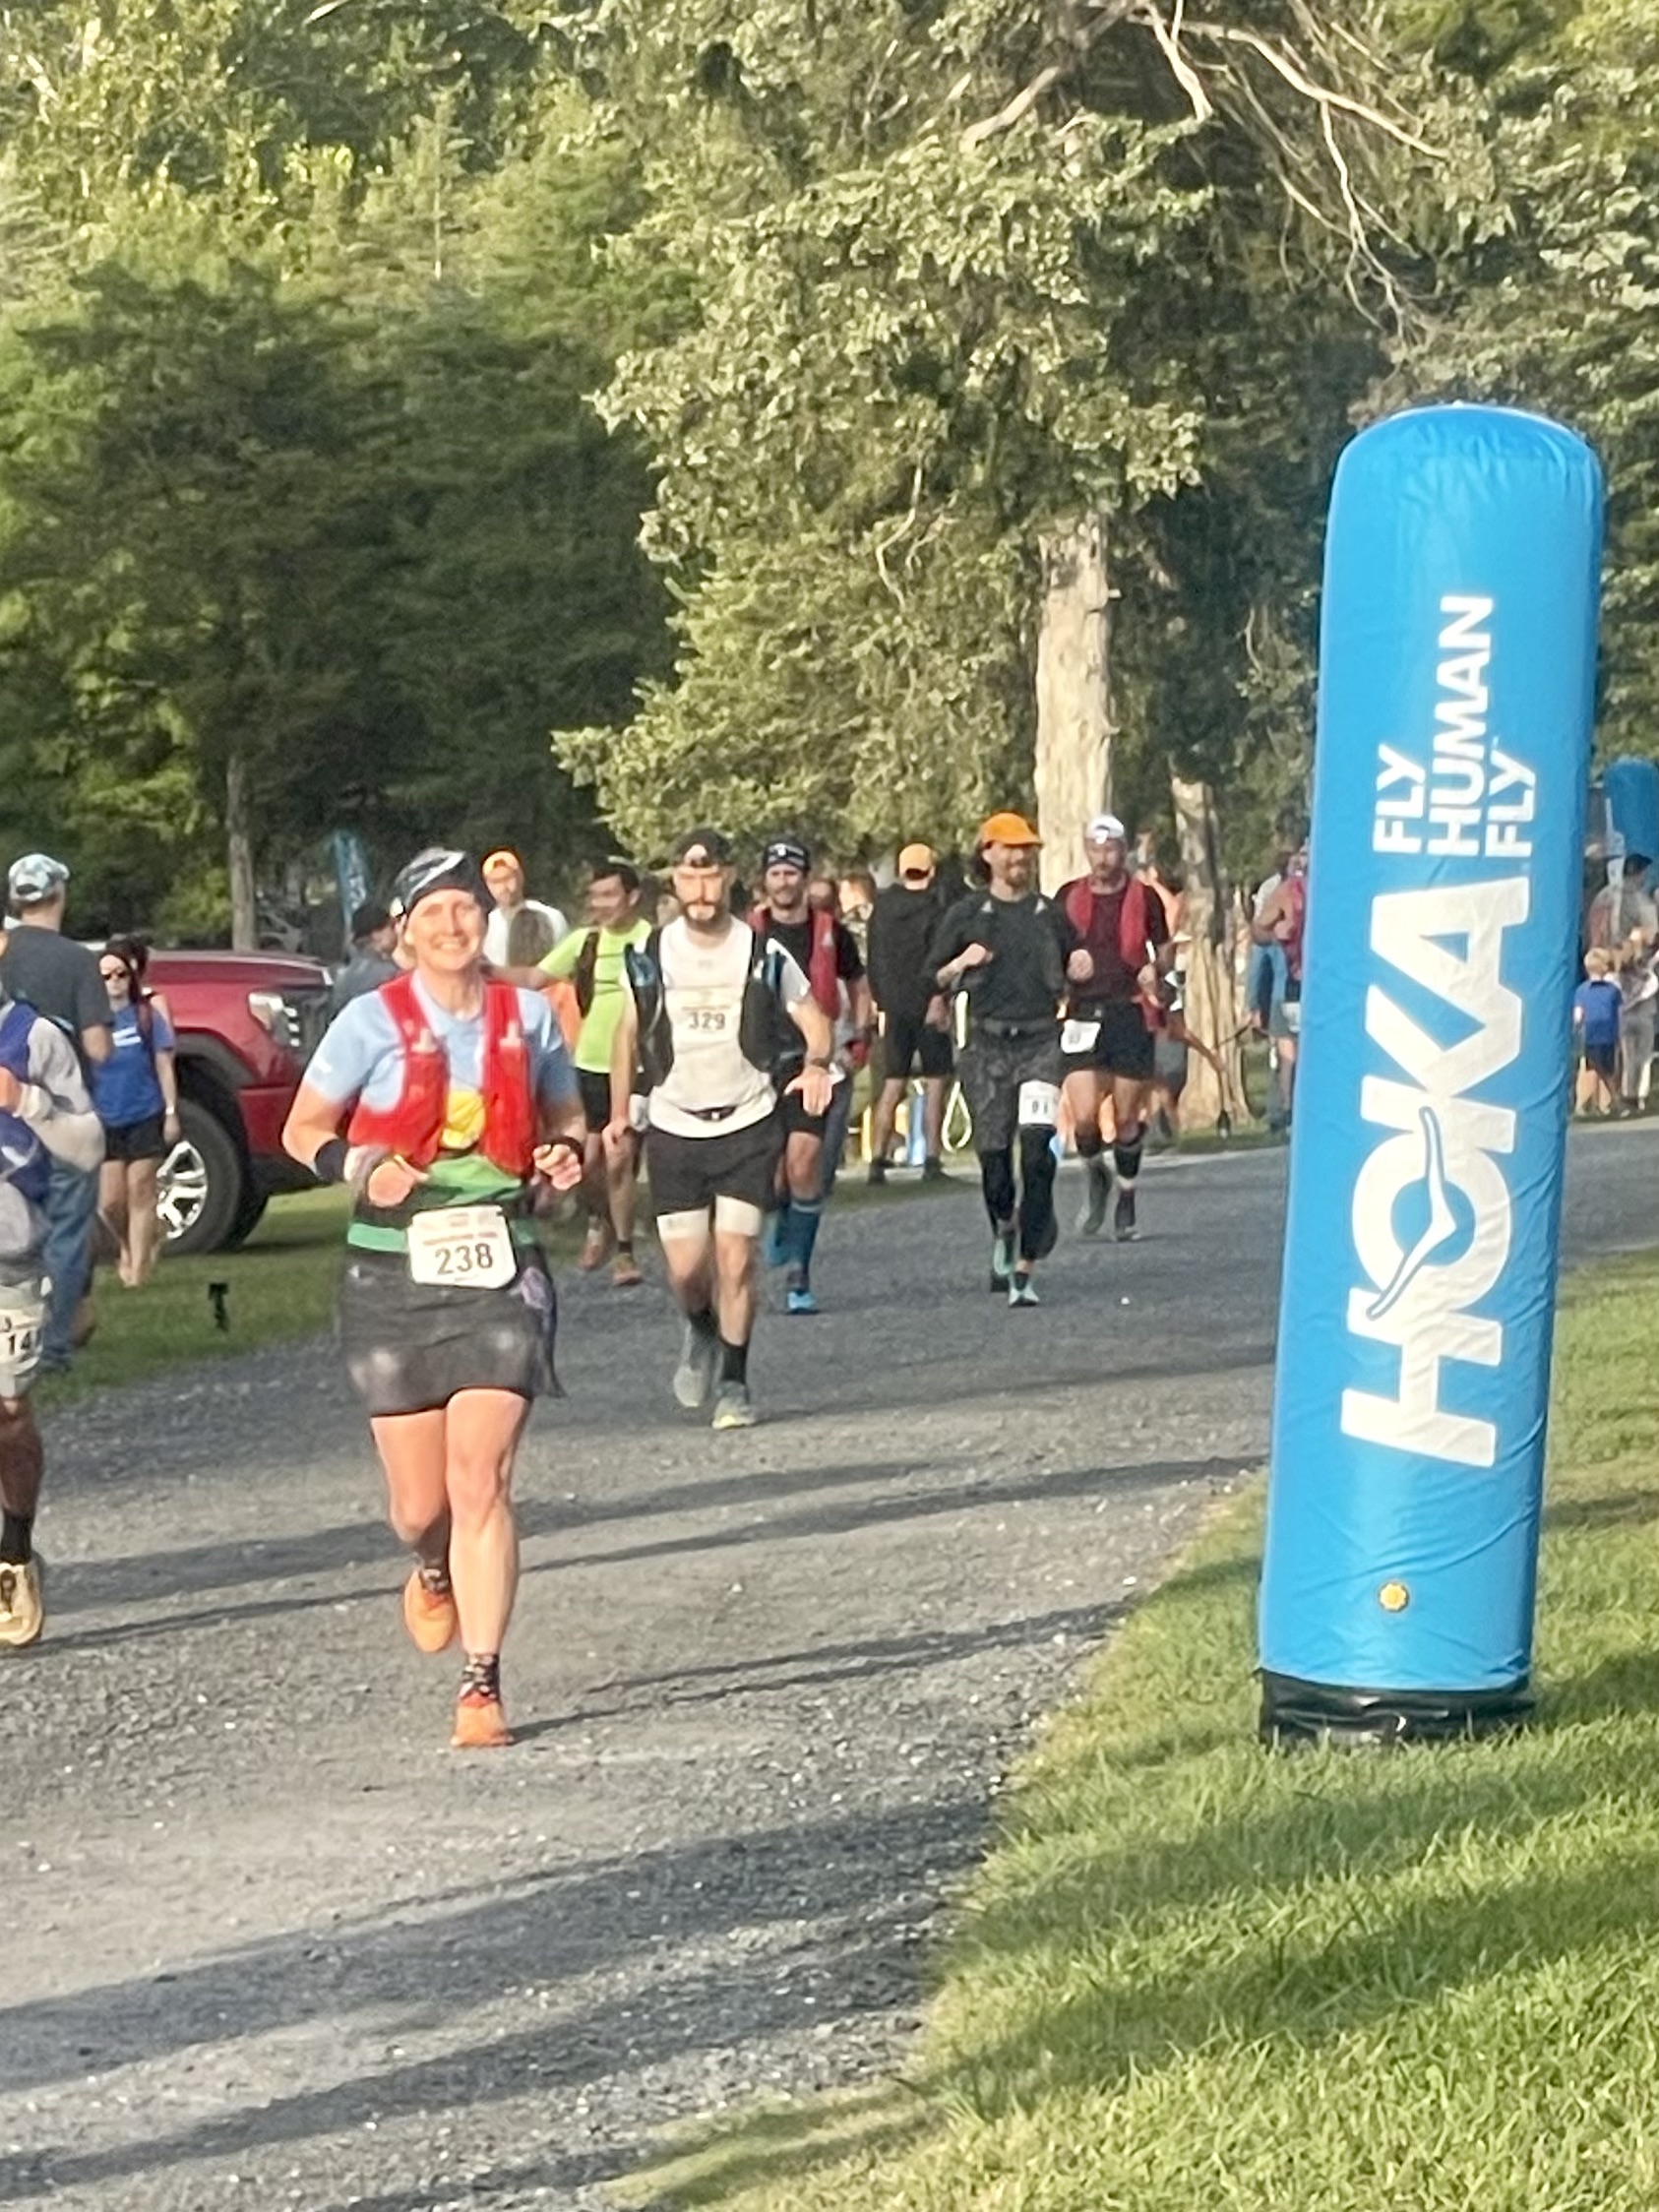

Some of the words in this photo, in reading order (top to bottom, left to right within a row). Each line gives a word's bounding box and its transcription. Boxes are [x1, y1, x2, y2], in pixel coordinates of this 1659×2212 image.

[1427, 595, 1493, 857] HUMAN
[1373, 743, 1426, 854] FLY
[1485, 749, 1536, 858] FLY
[688, 1012, 726, 1030] 329
[1340, 876, 1530, 1467] HOKA
[434, 1242, 494, 1275] 238
